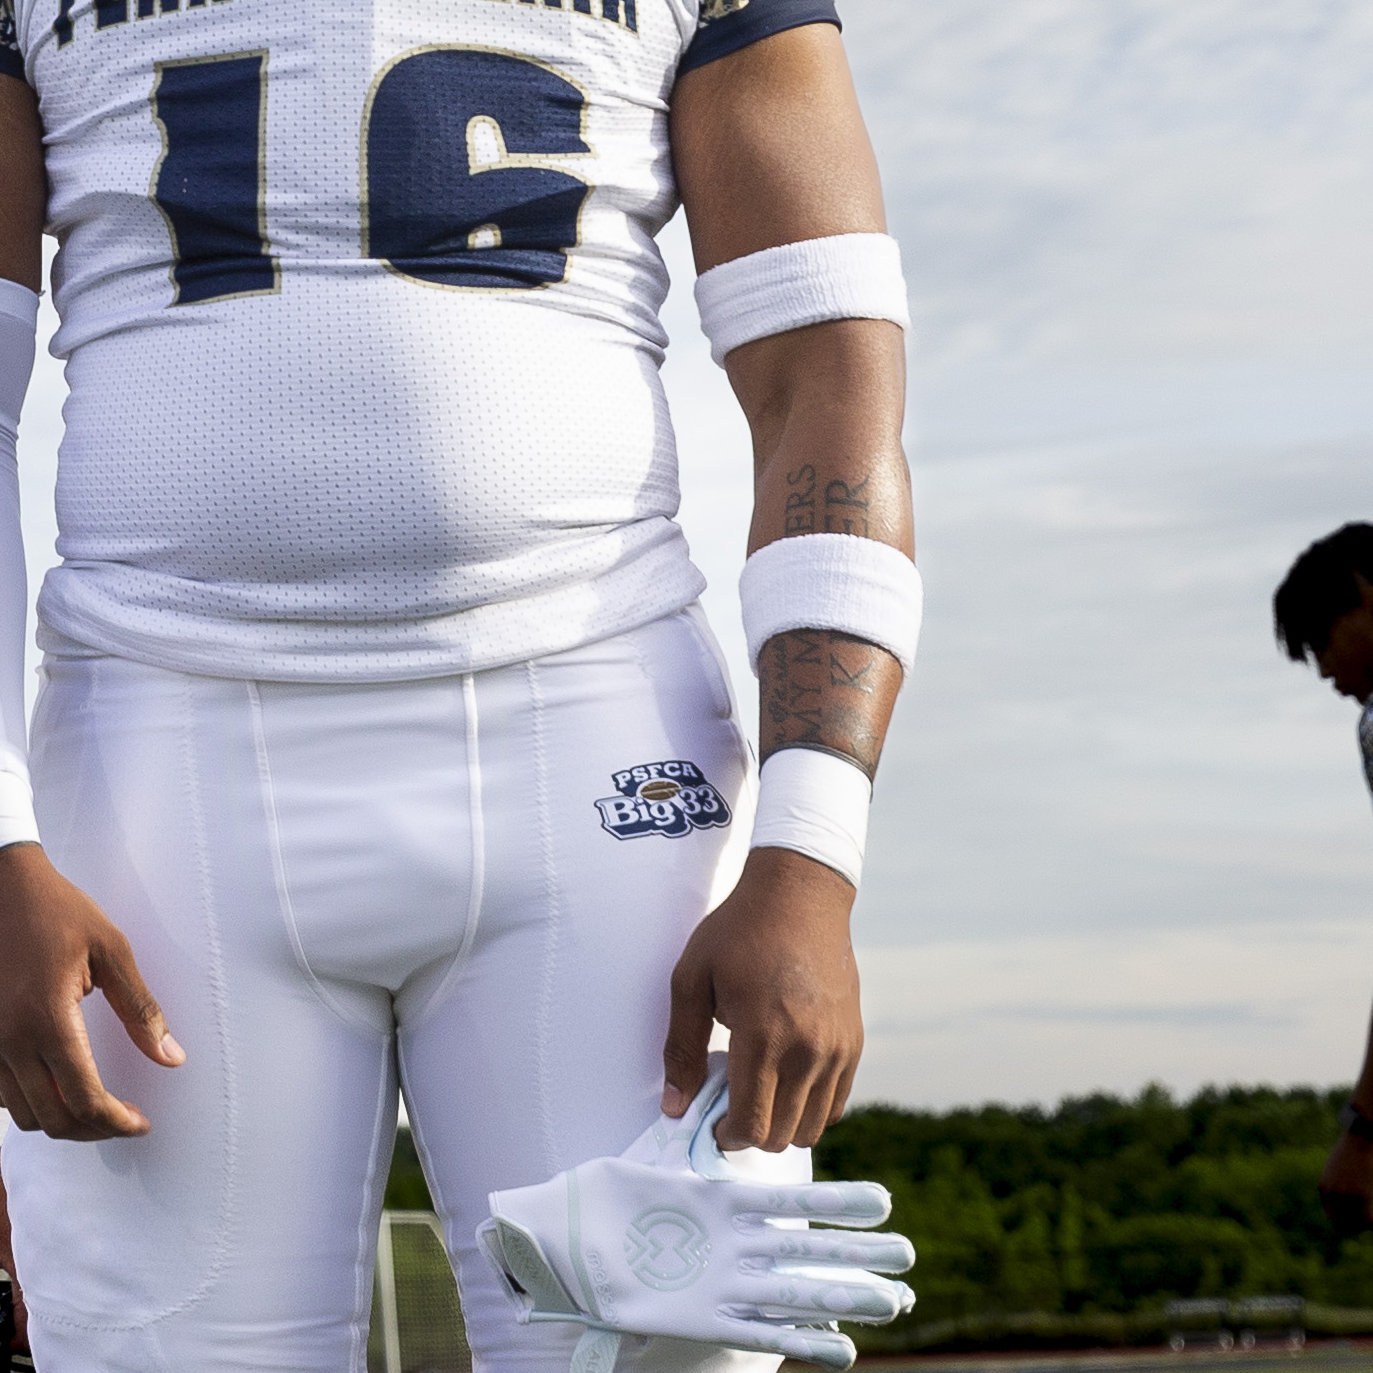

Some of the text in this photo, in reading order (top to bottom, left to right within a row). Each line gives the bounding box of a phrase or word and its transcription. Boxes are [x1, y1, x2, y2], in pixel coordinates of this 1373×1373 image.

[147, 44, 597, 307] 16
[614, 762, 698, 788] PSFCA
[600, 784, 719, 826] Big 33
